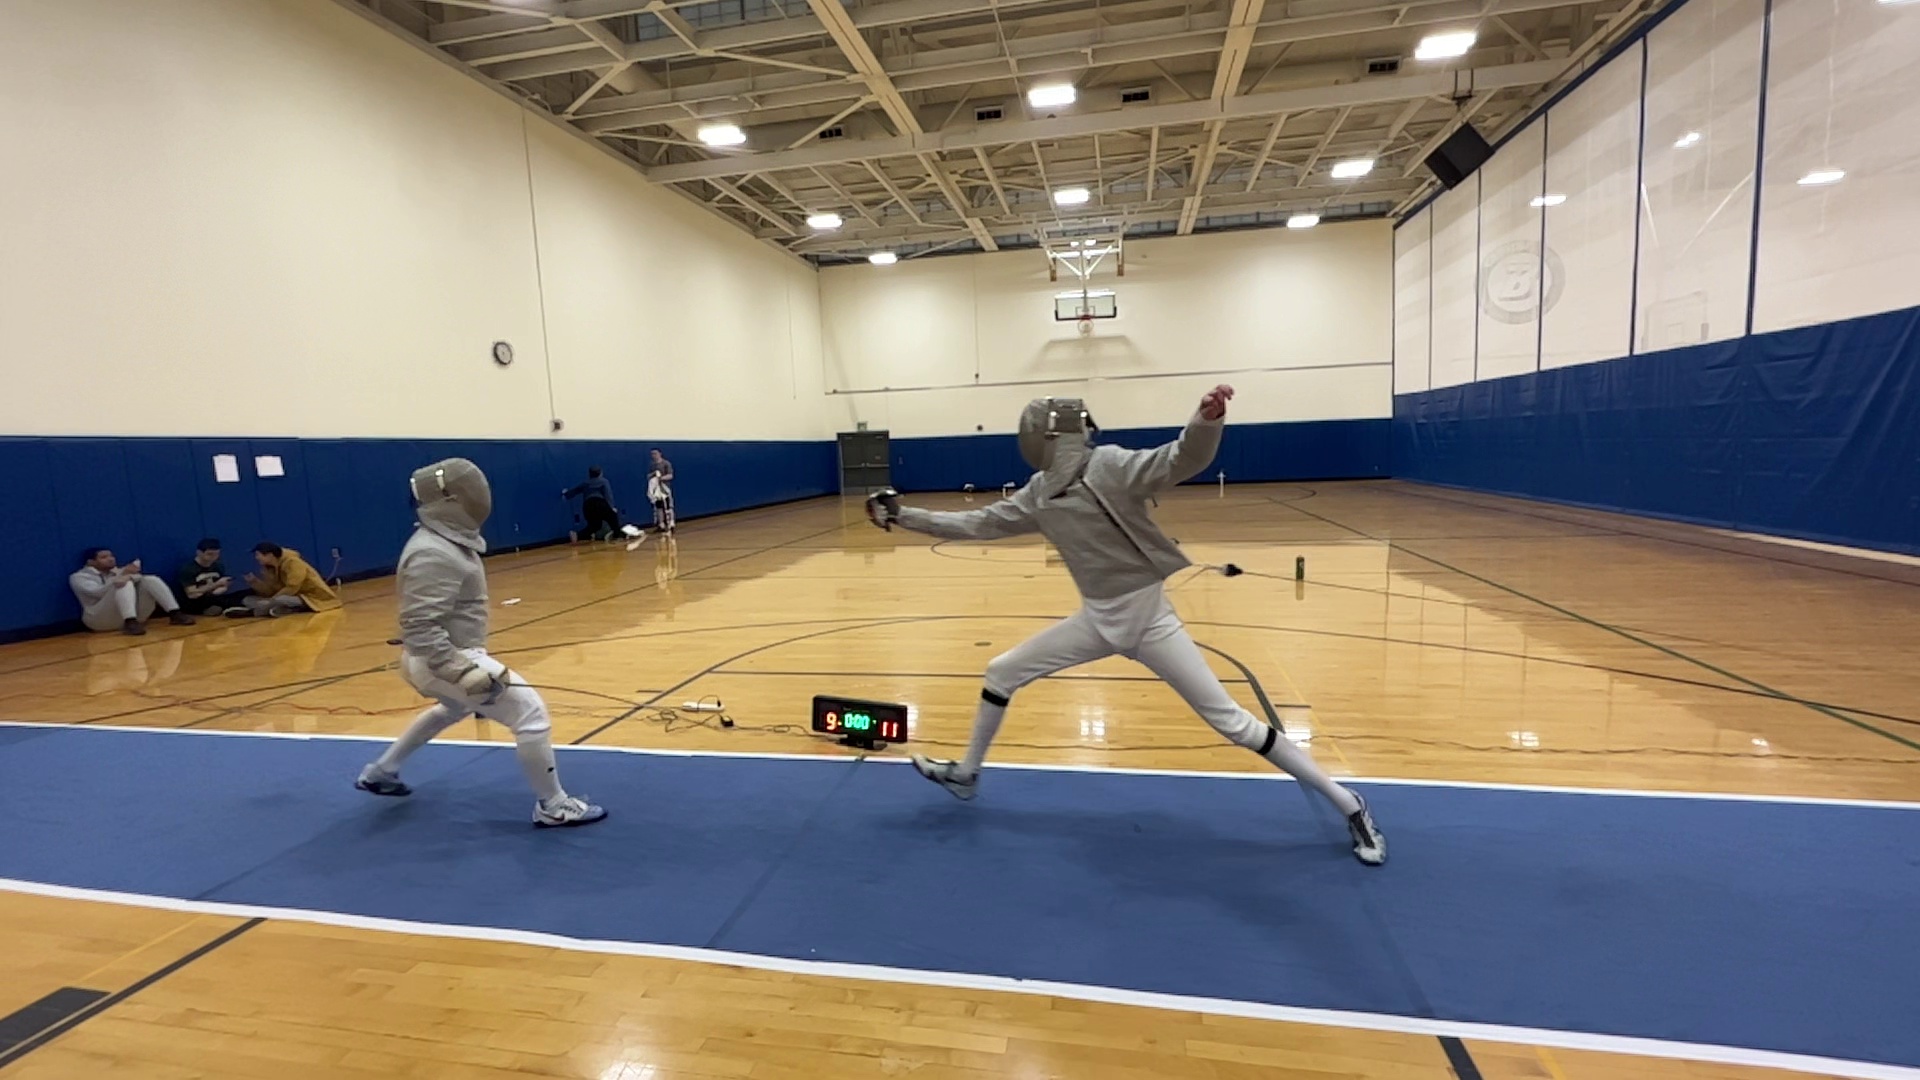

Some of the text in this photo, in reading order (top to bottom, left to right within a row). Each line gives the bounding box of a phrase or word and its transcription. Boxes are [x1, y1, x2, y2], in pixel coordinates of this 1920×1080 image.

[826, 711, 898, 738] 9 0:00 11
